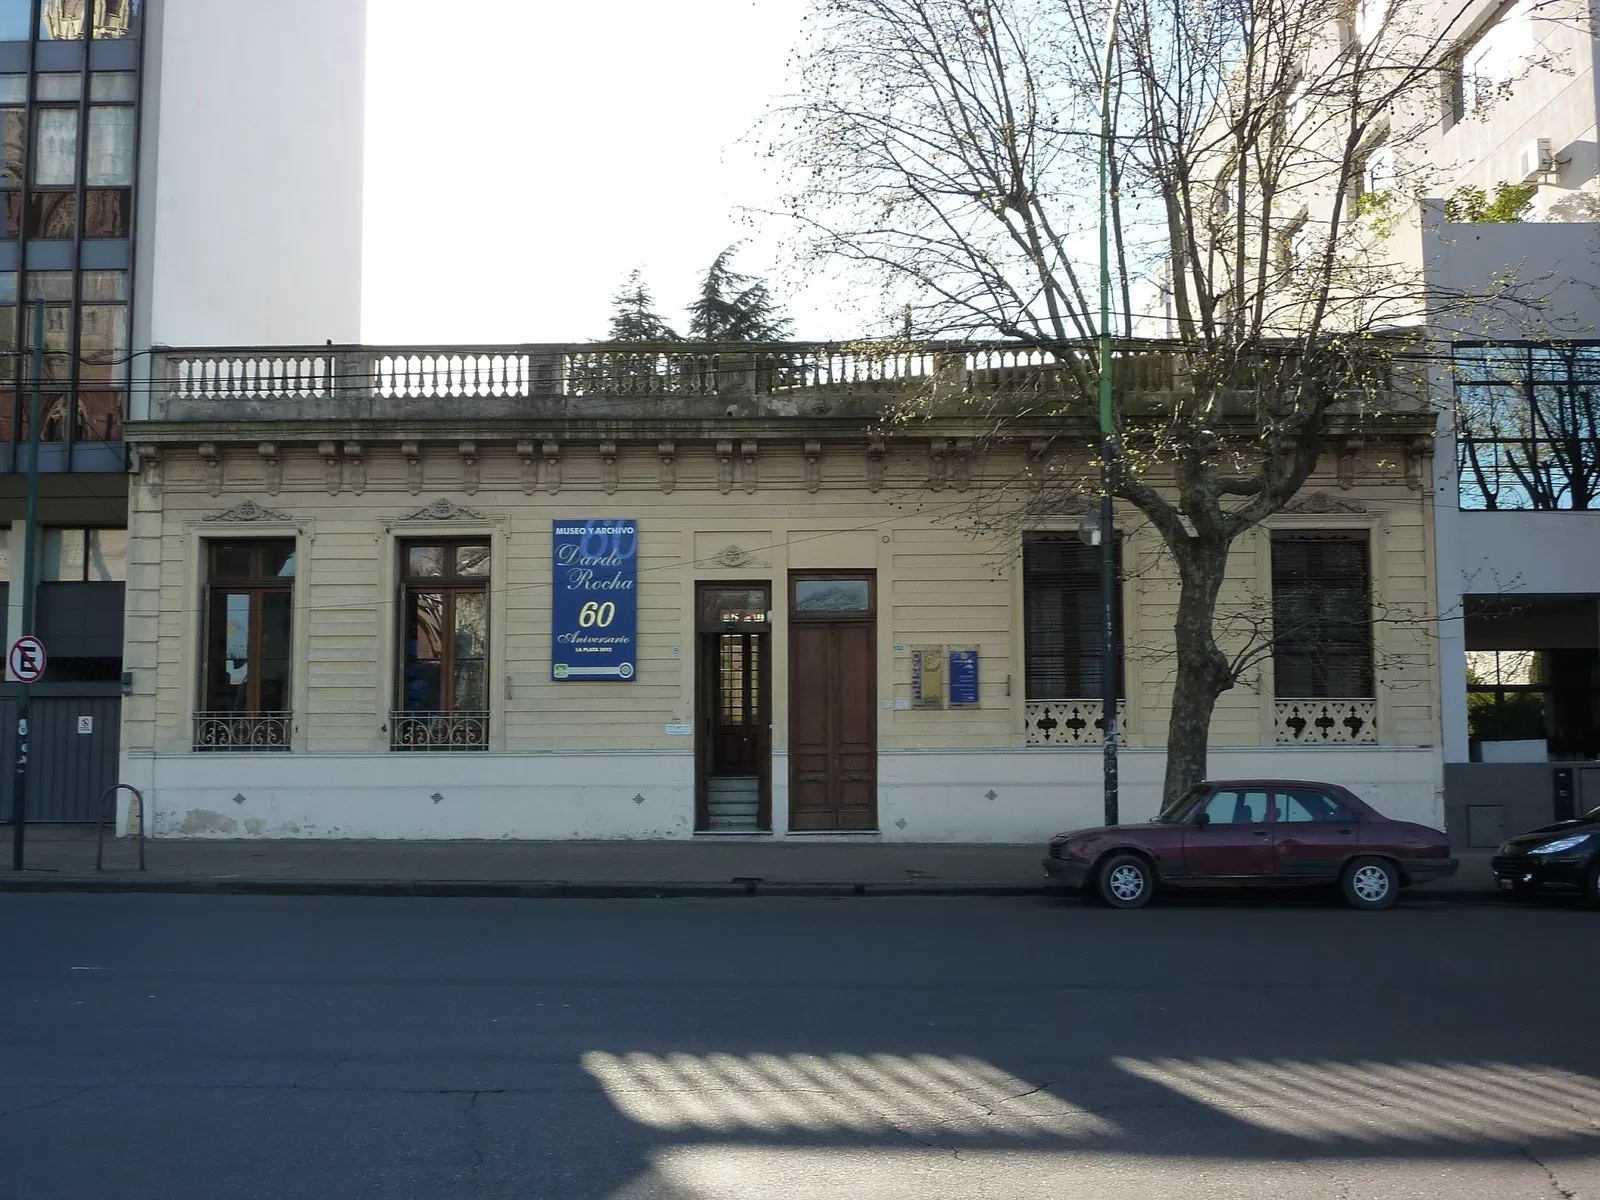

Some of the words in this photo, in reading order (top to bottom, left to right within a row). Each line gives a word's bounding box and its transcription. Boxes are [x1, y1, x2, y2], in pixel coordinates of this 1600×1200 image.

[555, 527, 586, 535] MUSEO
[588, 527, 595, 535] Y
[595, 526, 634, 535] ARCHIVO
[555, 543, 622, 566] Dardo
[567, 567, 633, 590] Rocha
[579, 601, 615, 628] 60
[557, 630, 630, 644] Aniversario
[20, 646, 37, 672] E
